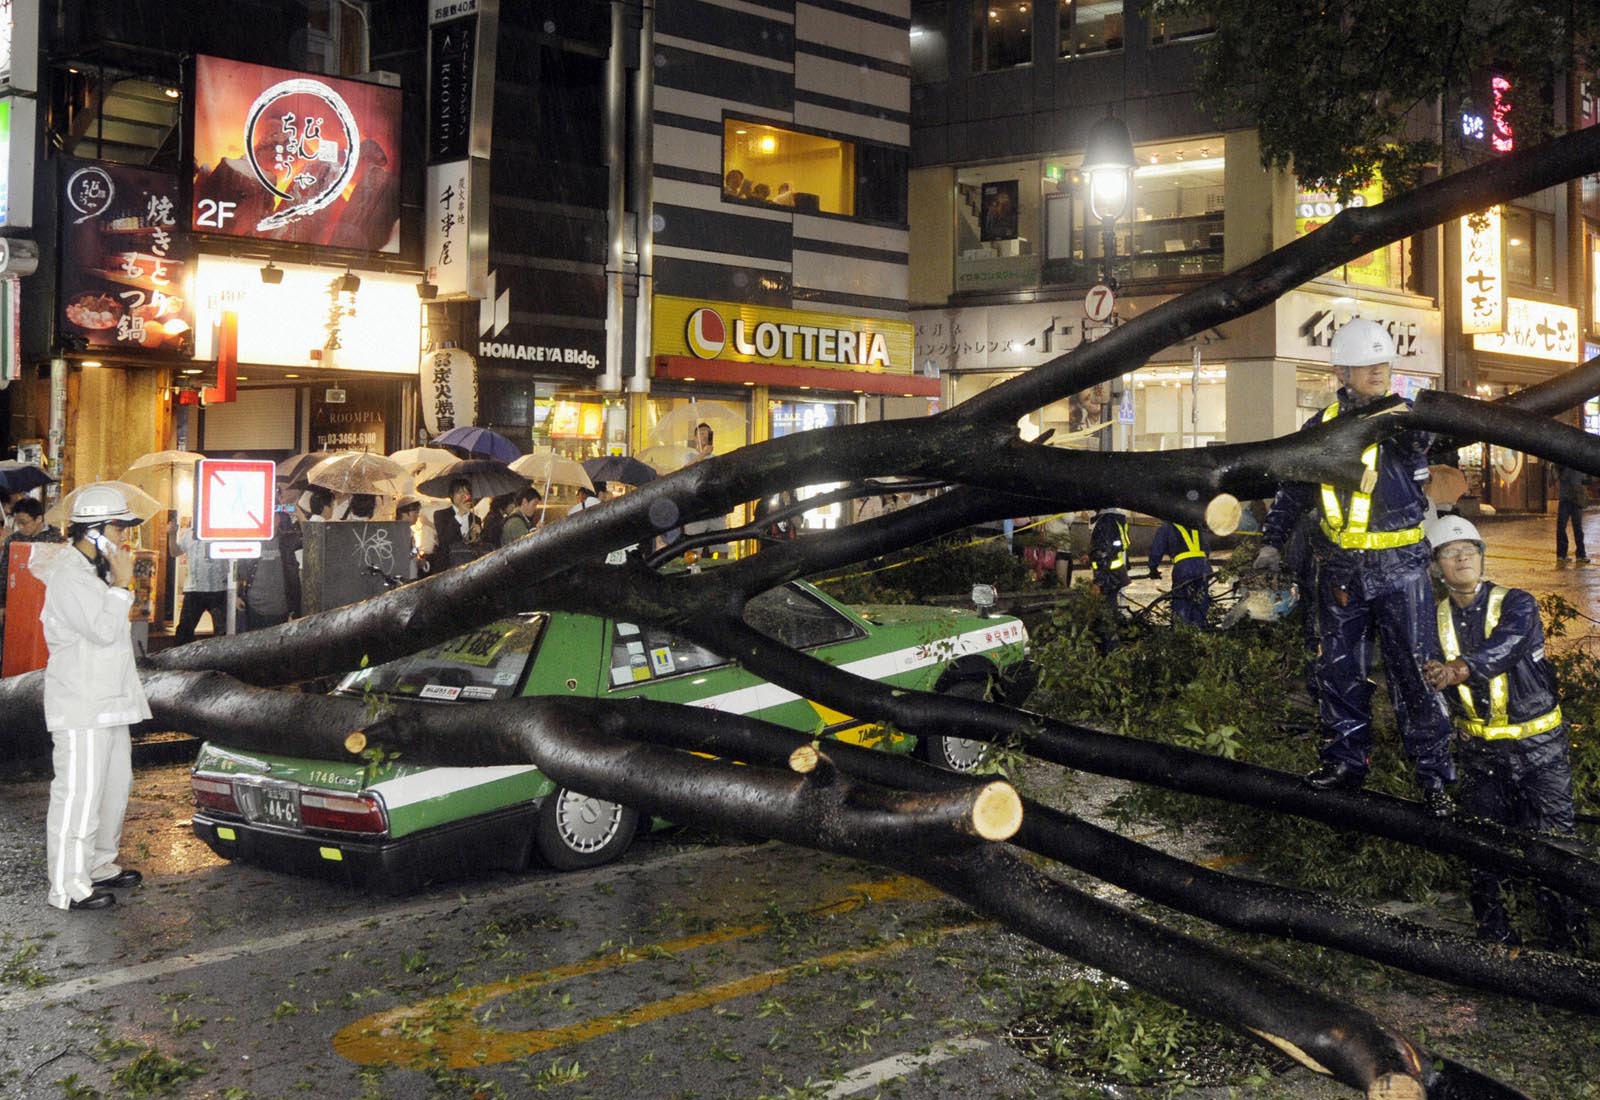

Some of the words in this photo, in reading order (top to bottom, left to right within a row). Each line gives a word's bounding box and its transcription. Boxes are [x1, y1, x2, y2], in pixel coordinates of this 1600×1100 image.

[196, 199, 237, 228] 2F
[117, 251, 147, 343] もつ鍋
[1092, 290, 1108, 316] 7
[480, 342, 562, 363] HOMAREYA
[564, 349, 600, 369] Bldg.
[734, 319, 891, 367] LOTTERIA
